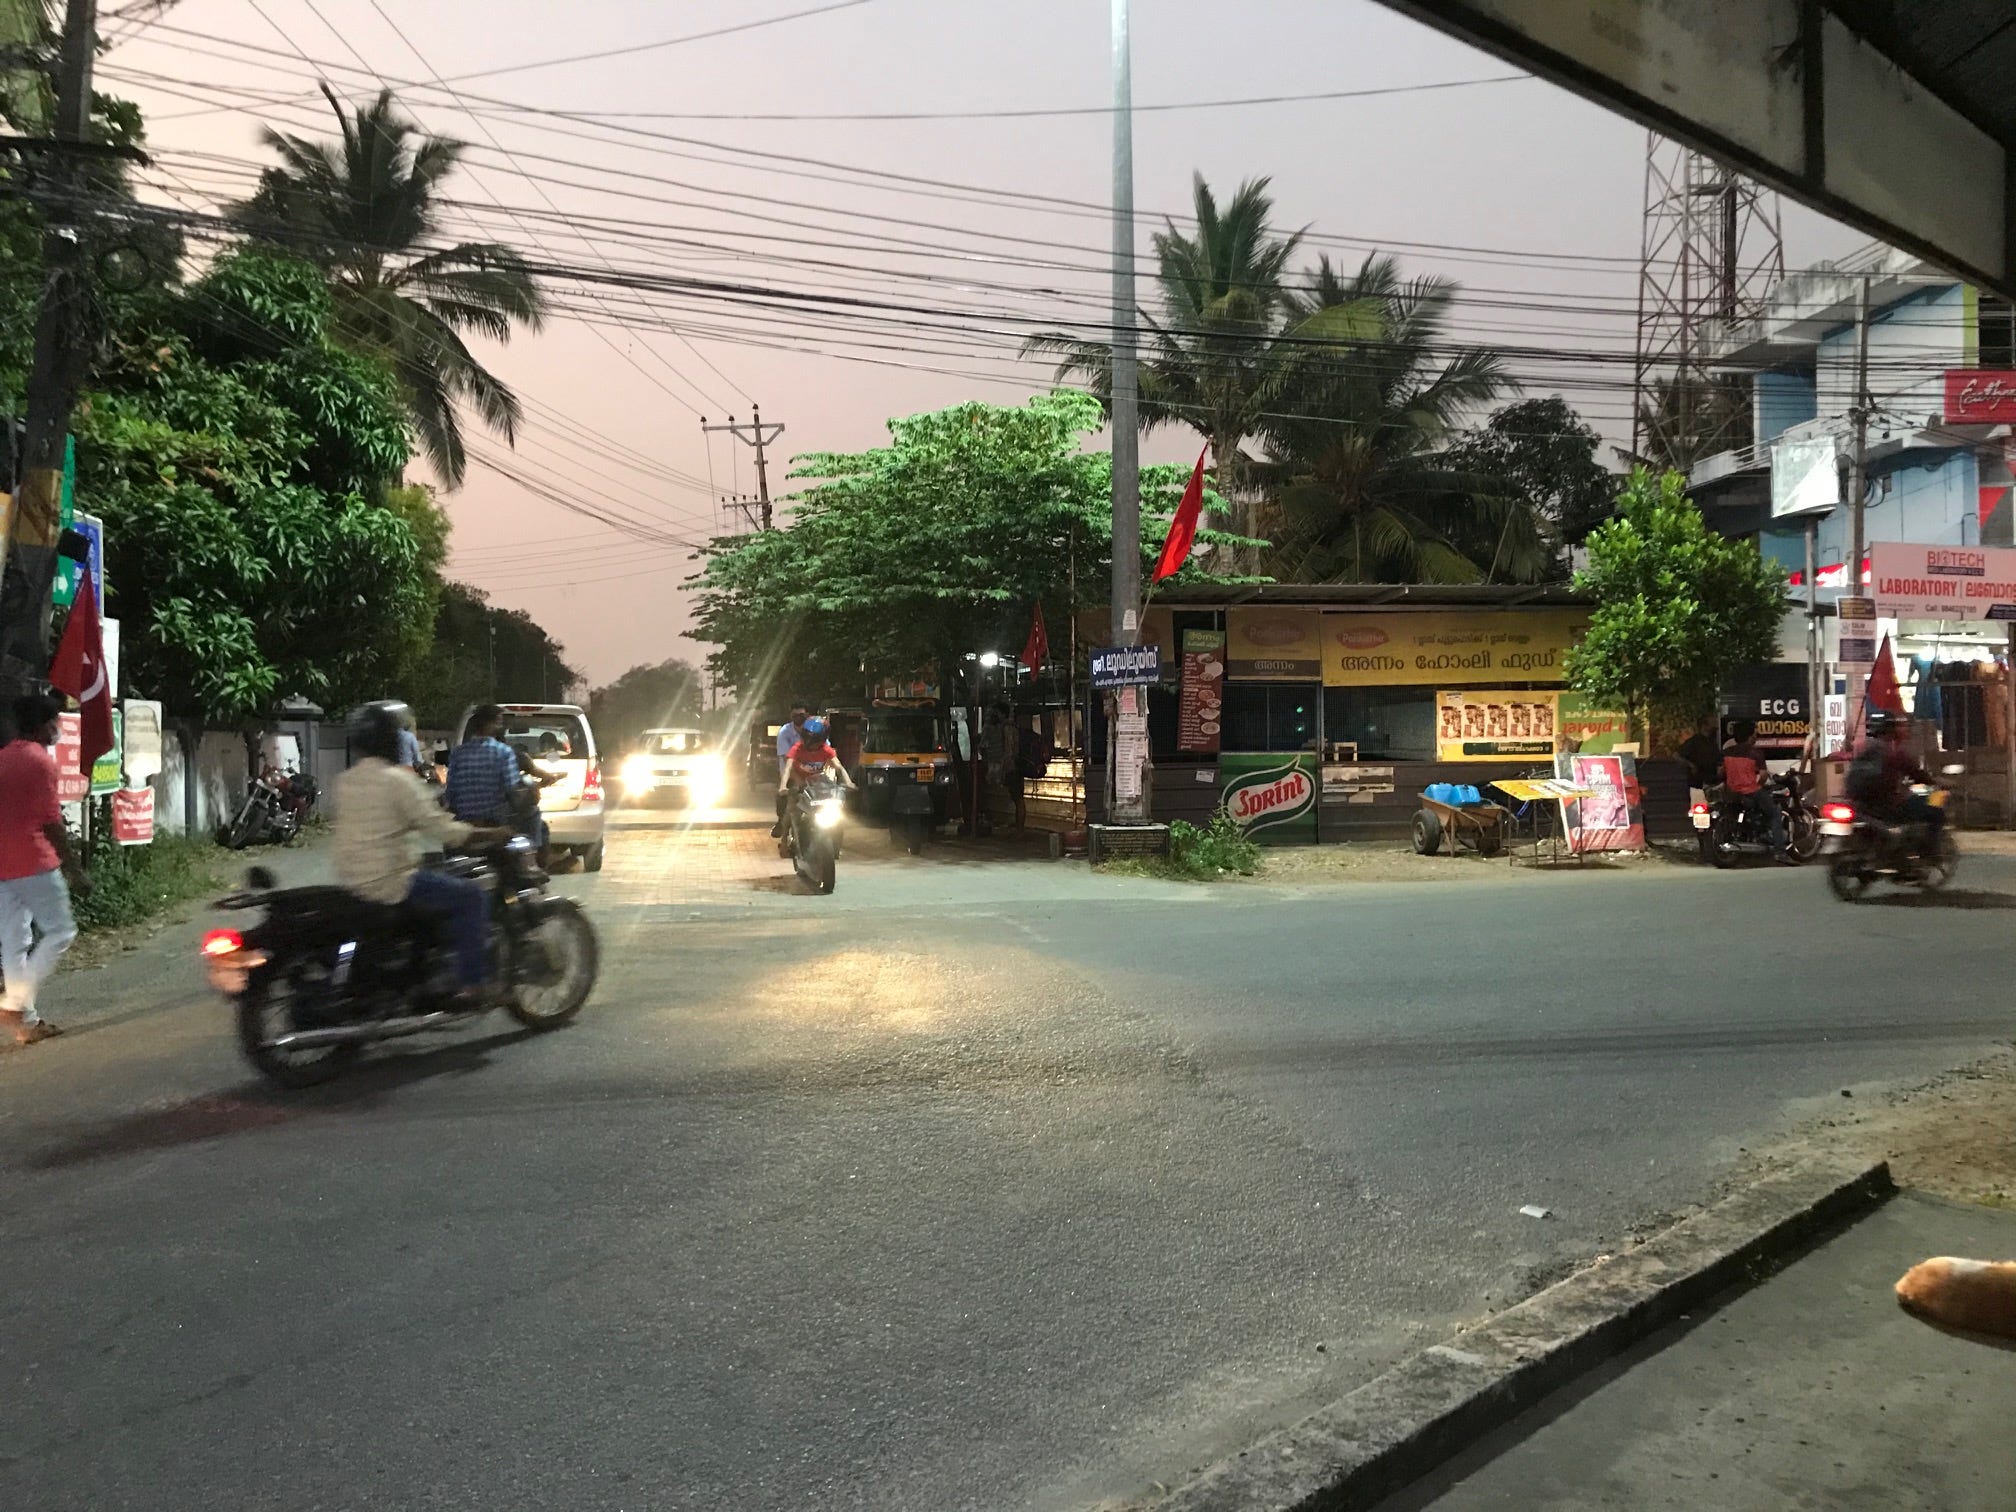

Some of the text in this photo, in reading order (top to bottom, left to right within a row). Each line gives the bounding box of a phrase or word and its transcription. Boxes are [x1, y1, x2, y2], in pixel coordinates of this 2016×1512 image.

[1879, 578, 1958, 597] LABORATORY
[1341, 655, 1404, 671] അന്നം
[1760, 699, 1800, 715] ECG
